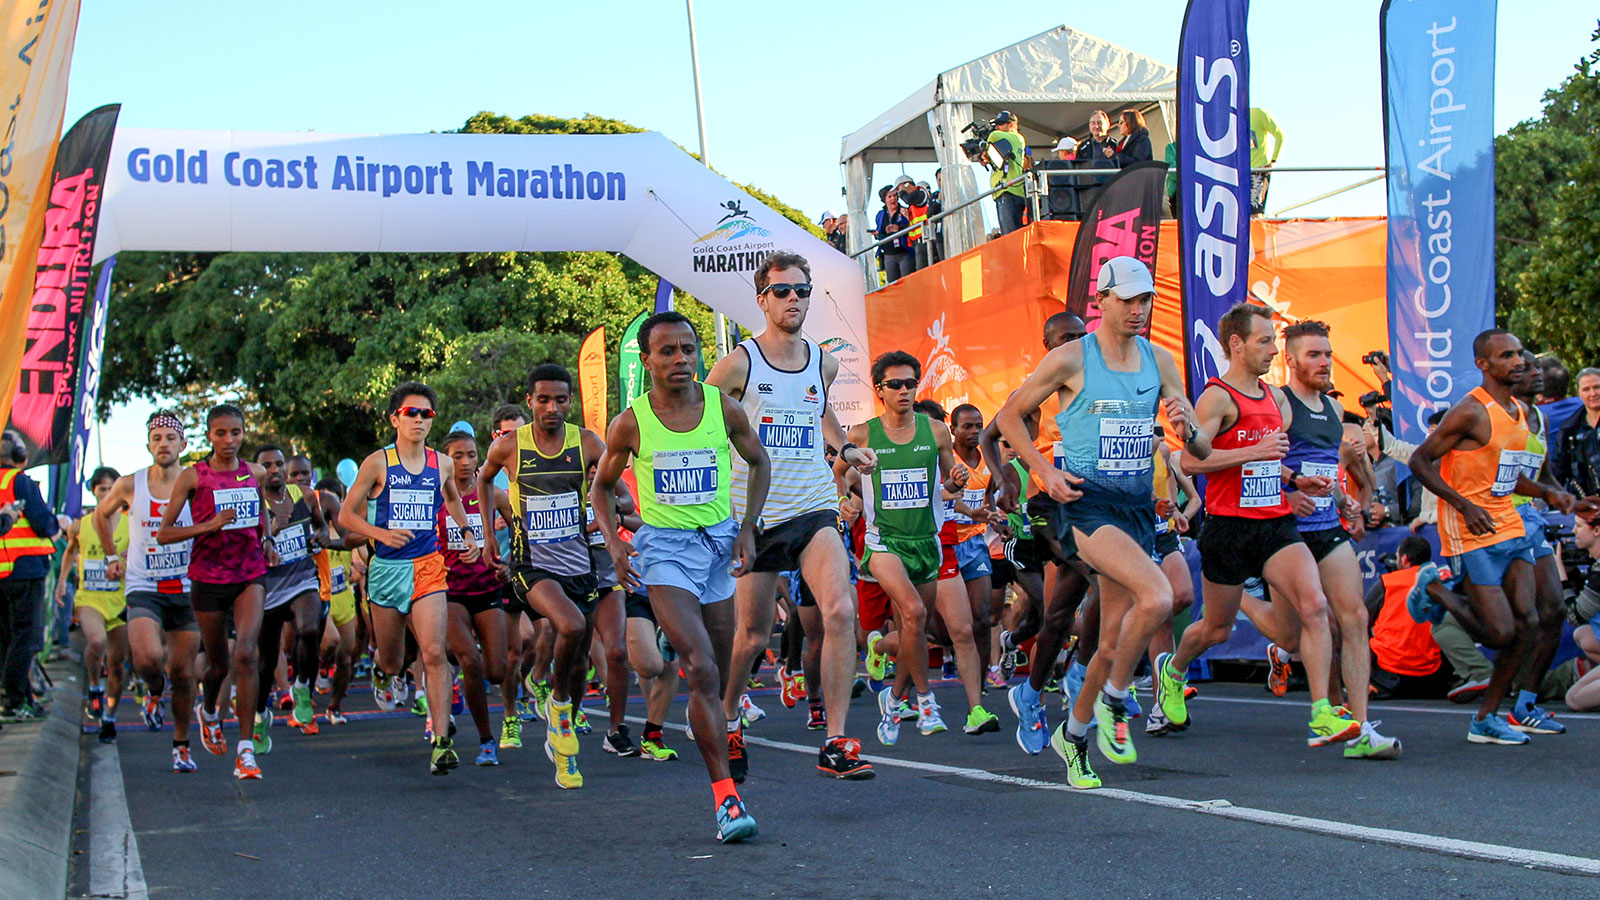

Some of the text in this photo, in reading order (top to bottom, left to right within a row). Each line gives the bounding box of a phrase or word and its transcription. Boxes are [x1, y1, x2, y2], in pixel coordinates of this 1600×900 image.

[127, 147, 626, 201] Gold Coast Airport Marathon
[1414, 15, 1466, 435] Gold Coast Airport
[692, 241, 774, 254] Gold Coast Airport
[627, 362, 637, 408] port
[783, 415, 794, 424] 70
[765, 426, 803, 447] MUMBY
[1119, 425, 1143, 435] PACE
[1101, 437, 1149, 459] WESTCOTT
[682, 456, 689, 467] 9
[1261, 466, 1270, 475] 28
[661, 469, 704, 493] SAMMY
[231, 493, 243, 501] 103
[408, 494, 416, 502] 21
[886, 483, 920, 500] TAKADA
[392, 503, 426, 520] SUGAWA
[550, 500, 556, 508] 4
[530, 509, 573, 530] ADIHANA
[275, 538, 301, 555] EMEDA
[148, 553, 181, 569] DAWSON
